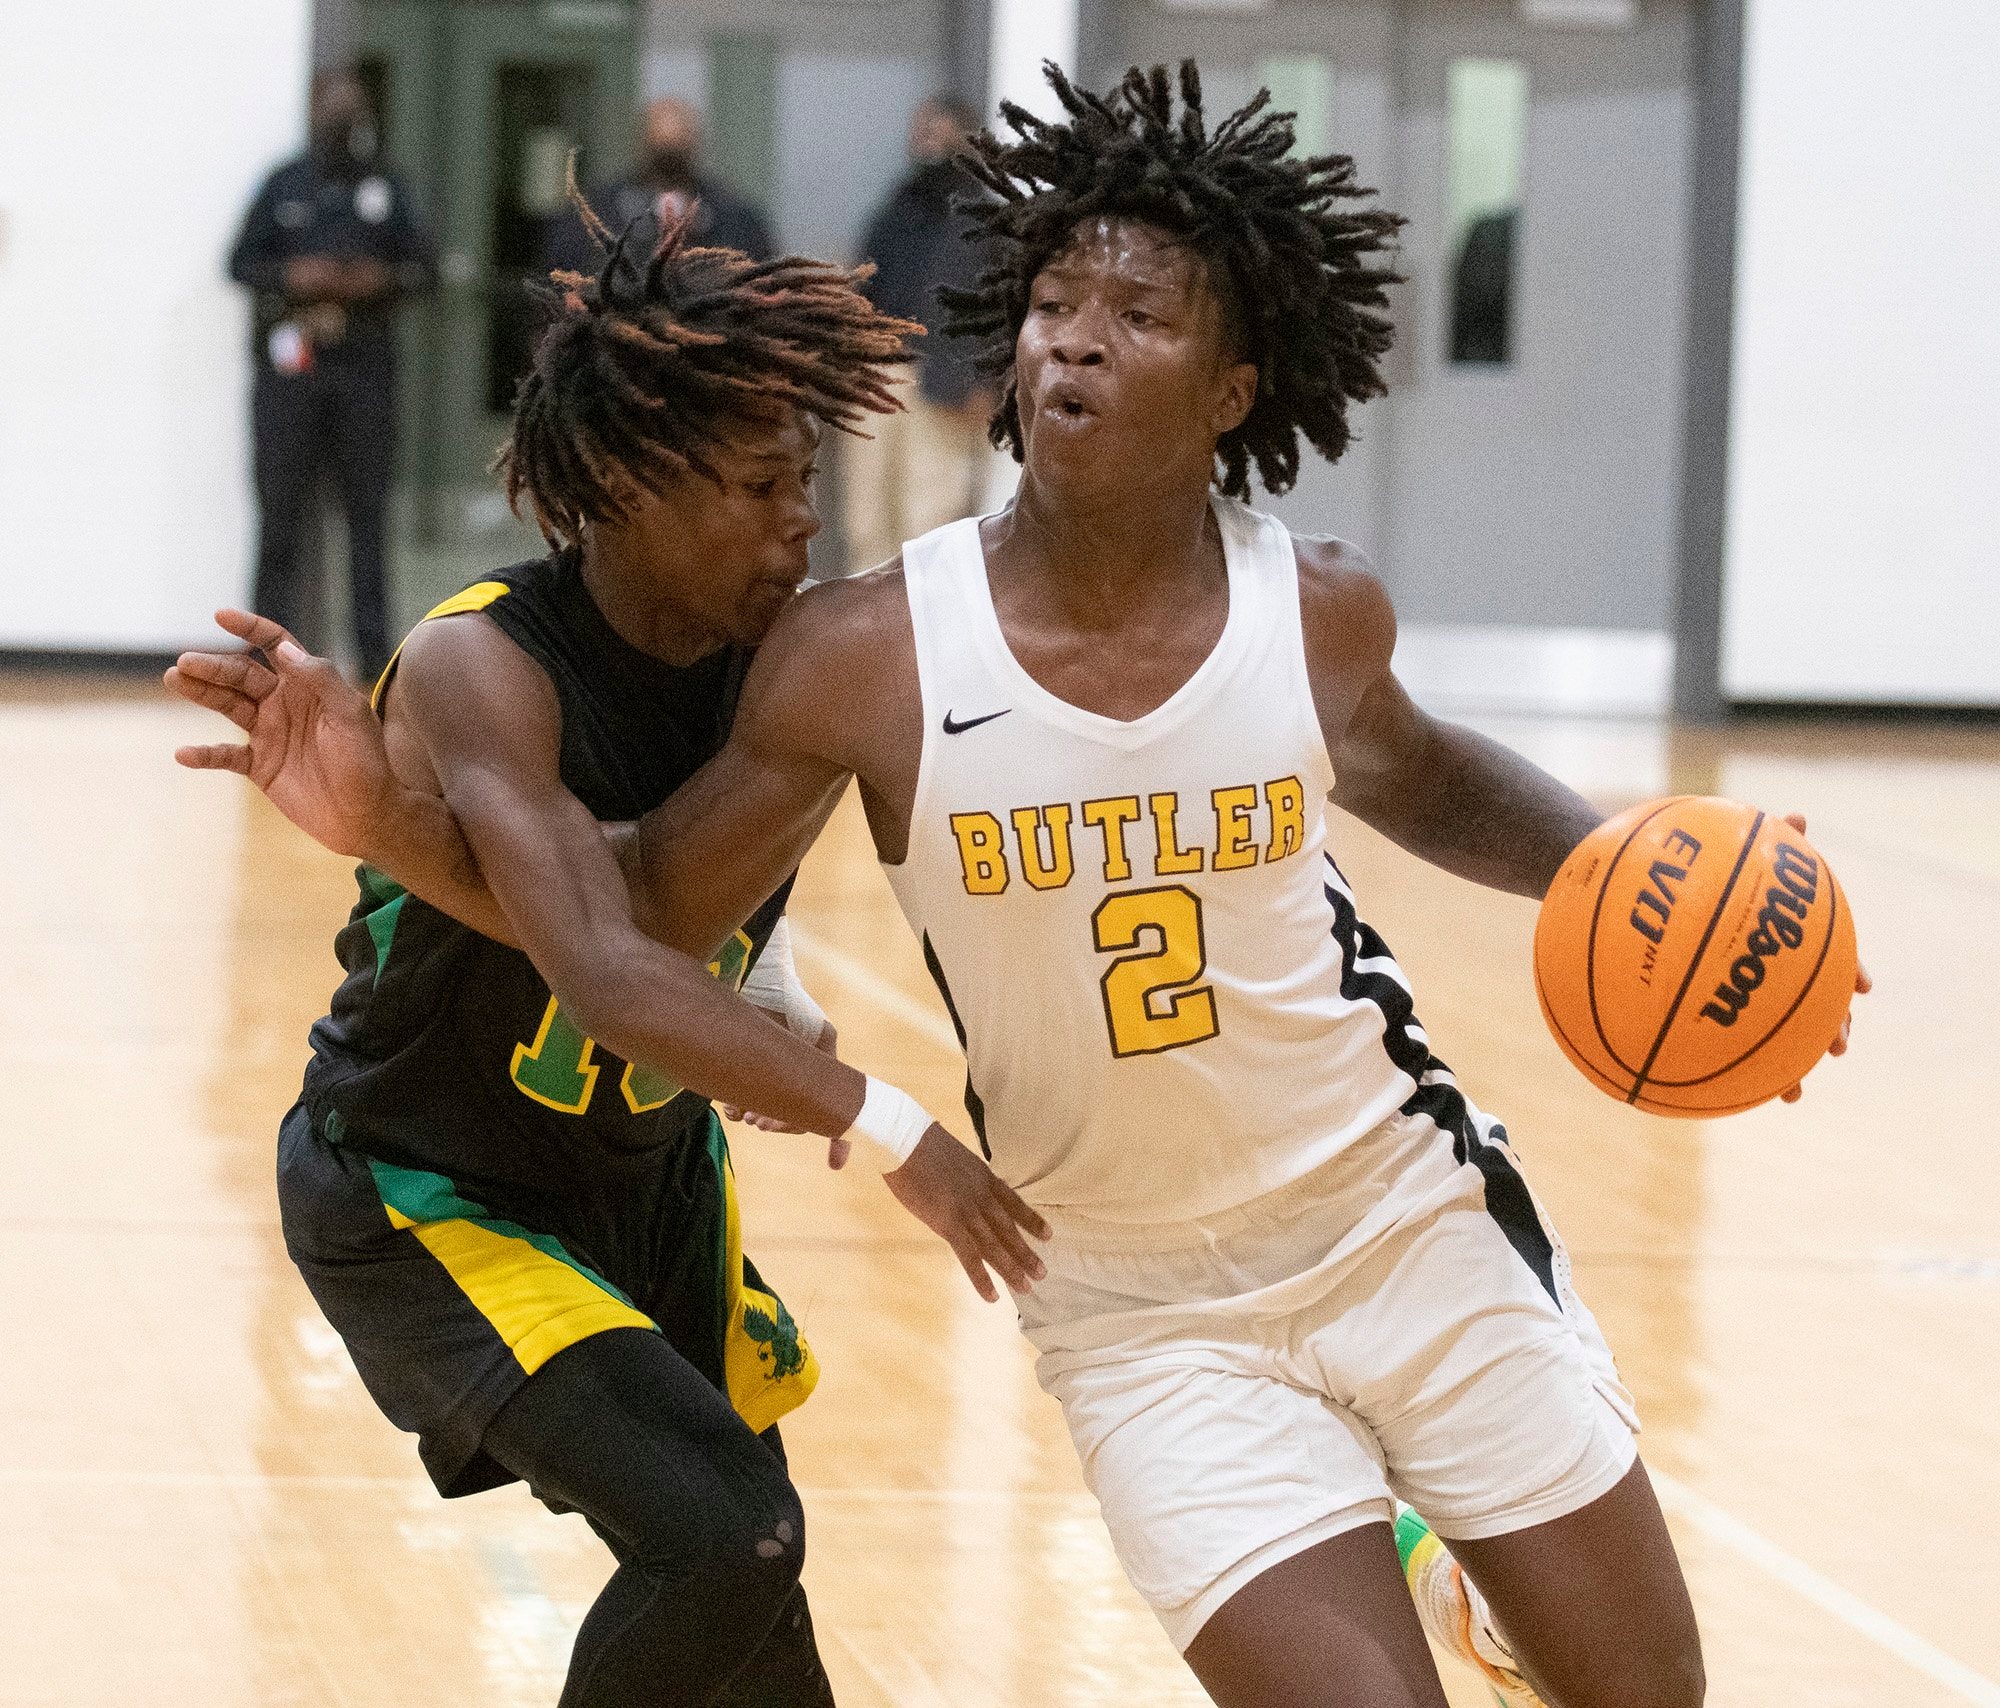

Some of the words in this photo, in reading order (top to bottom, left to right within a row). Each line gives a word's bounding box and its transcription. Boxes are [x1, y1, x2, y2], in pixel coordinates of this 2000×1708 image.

[949, 775, 1305, 895] BUTLER
[1629, 828, 1702, 944] EVO
[1090, 884, 1220, 1059] 2
[1700, 842, 1818, 1028] Wilson
